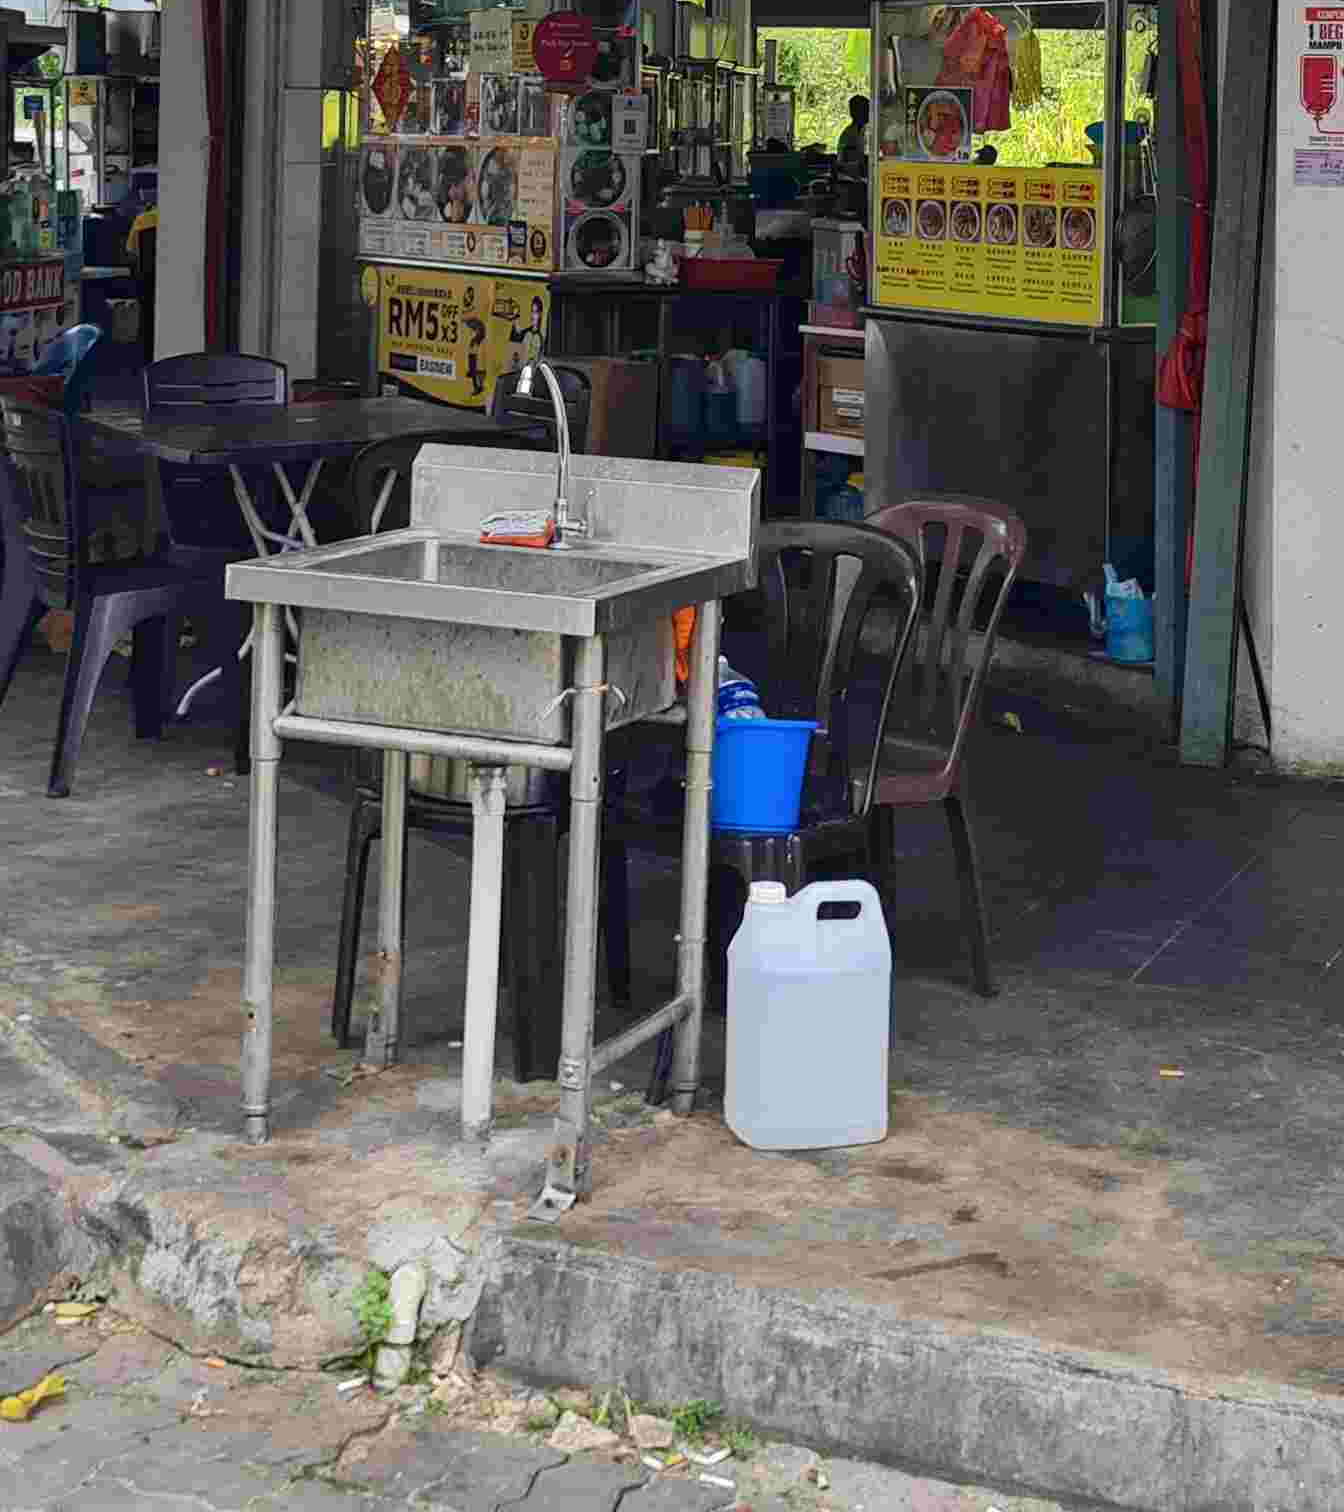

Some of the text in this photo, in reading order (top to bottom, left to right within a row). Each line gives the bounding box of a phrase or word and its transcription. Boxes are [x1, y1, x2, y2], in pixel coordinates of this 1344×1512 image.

[1319, 24, 1343, 40] BEG
[1309, 41, 1342, 50] MAMPU
[27, 267, 64, 300] BANK
[389, 297, 459, 340] RM5 OFF
[441, 322, 458, 343] x3
